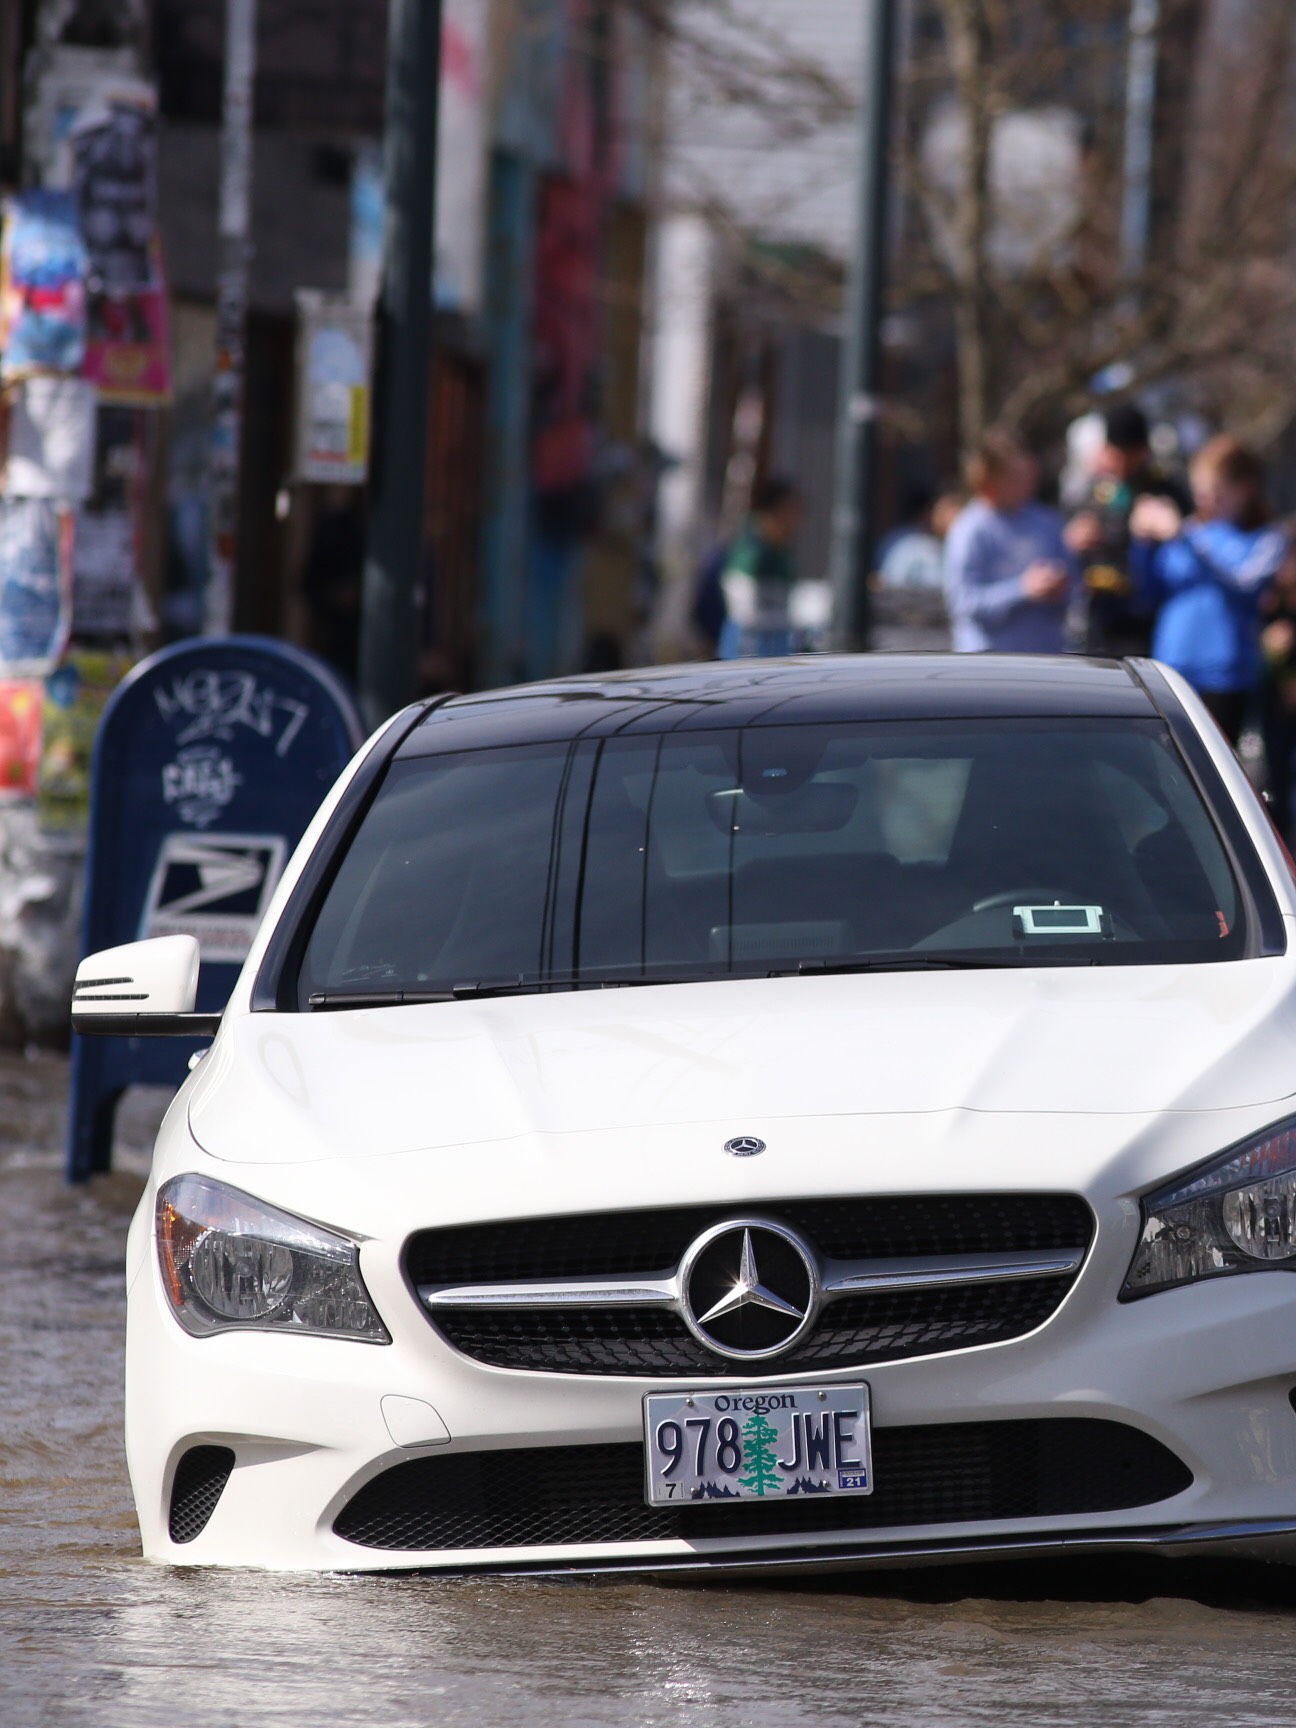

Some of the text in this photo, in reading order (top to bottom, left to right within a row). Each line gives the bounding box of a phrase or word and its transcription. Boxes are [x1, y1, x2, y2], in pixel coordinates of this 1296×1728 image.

[714, 1394, 797, 1414] Oregon
[657, 1411, 861, 1477] 978 JWE
[665, 1483, 676, 1498] 7
[846, 1477, 860, 1487] 21
